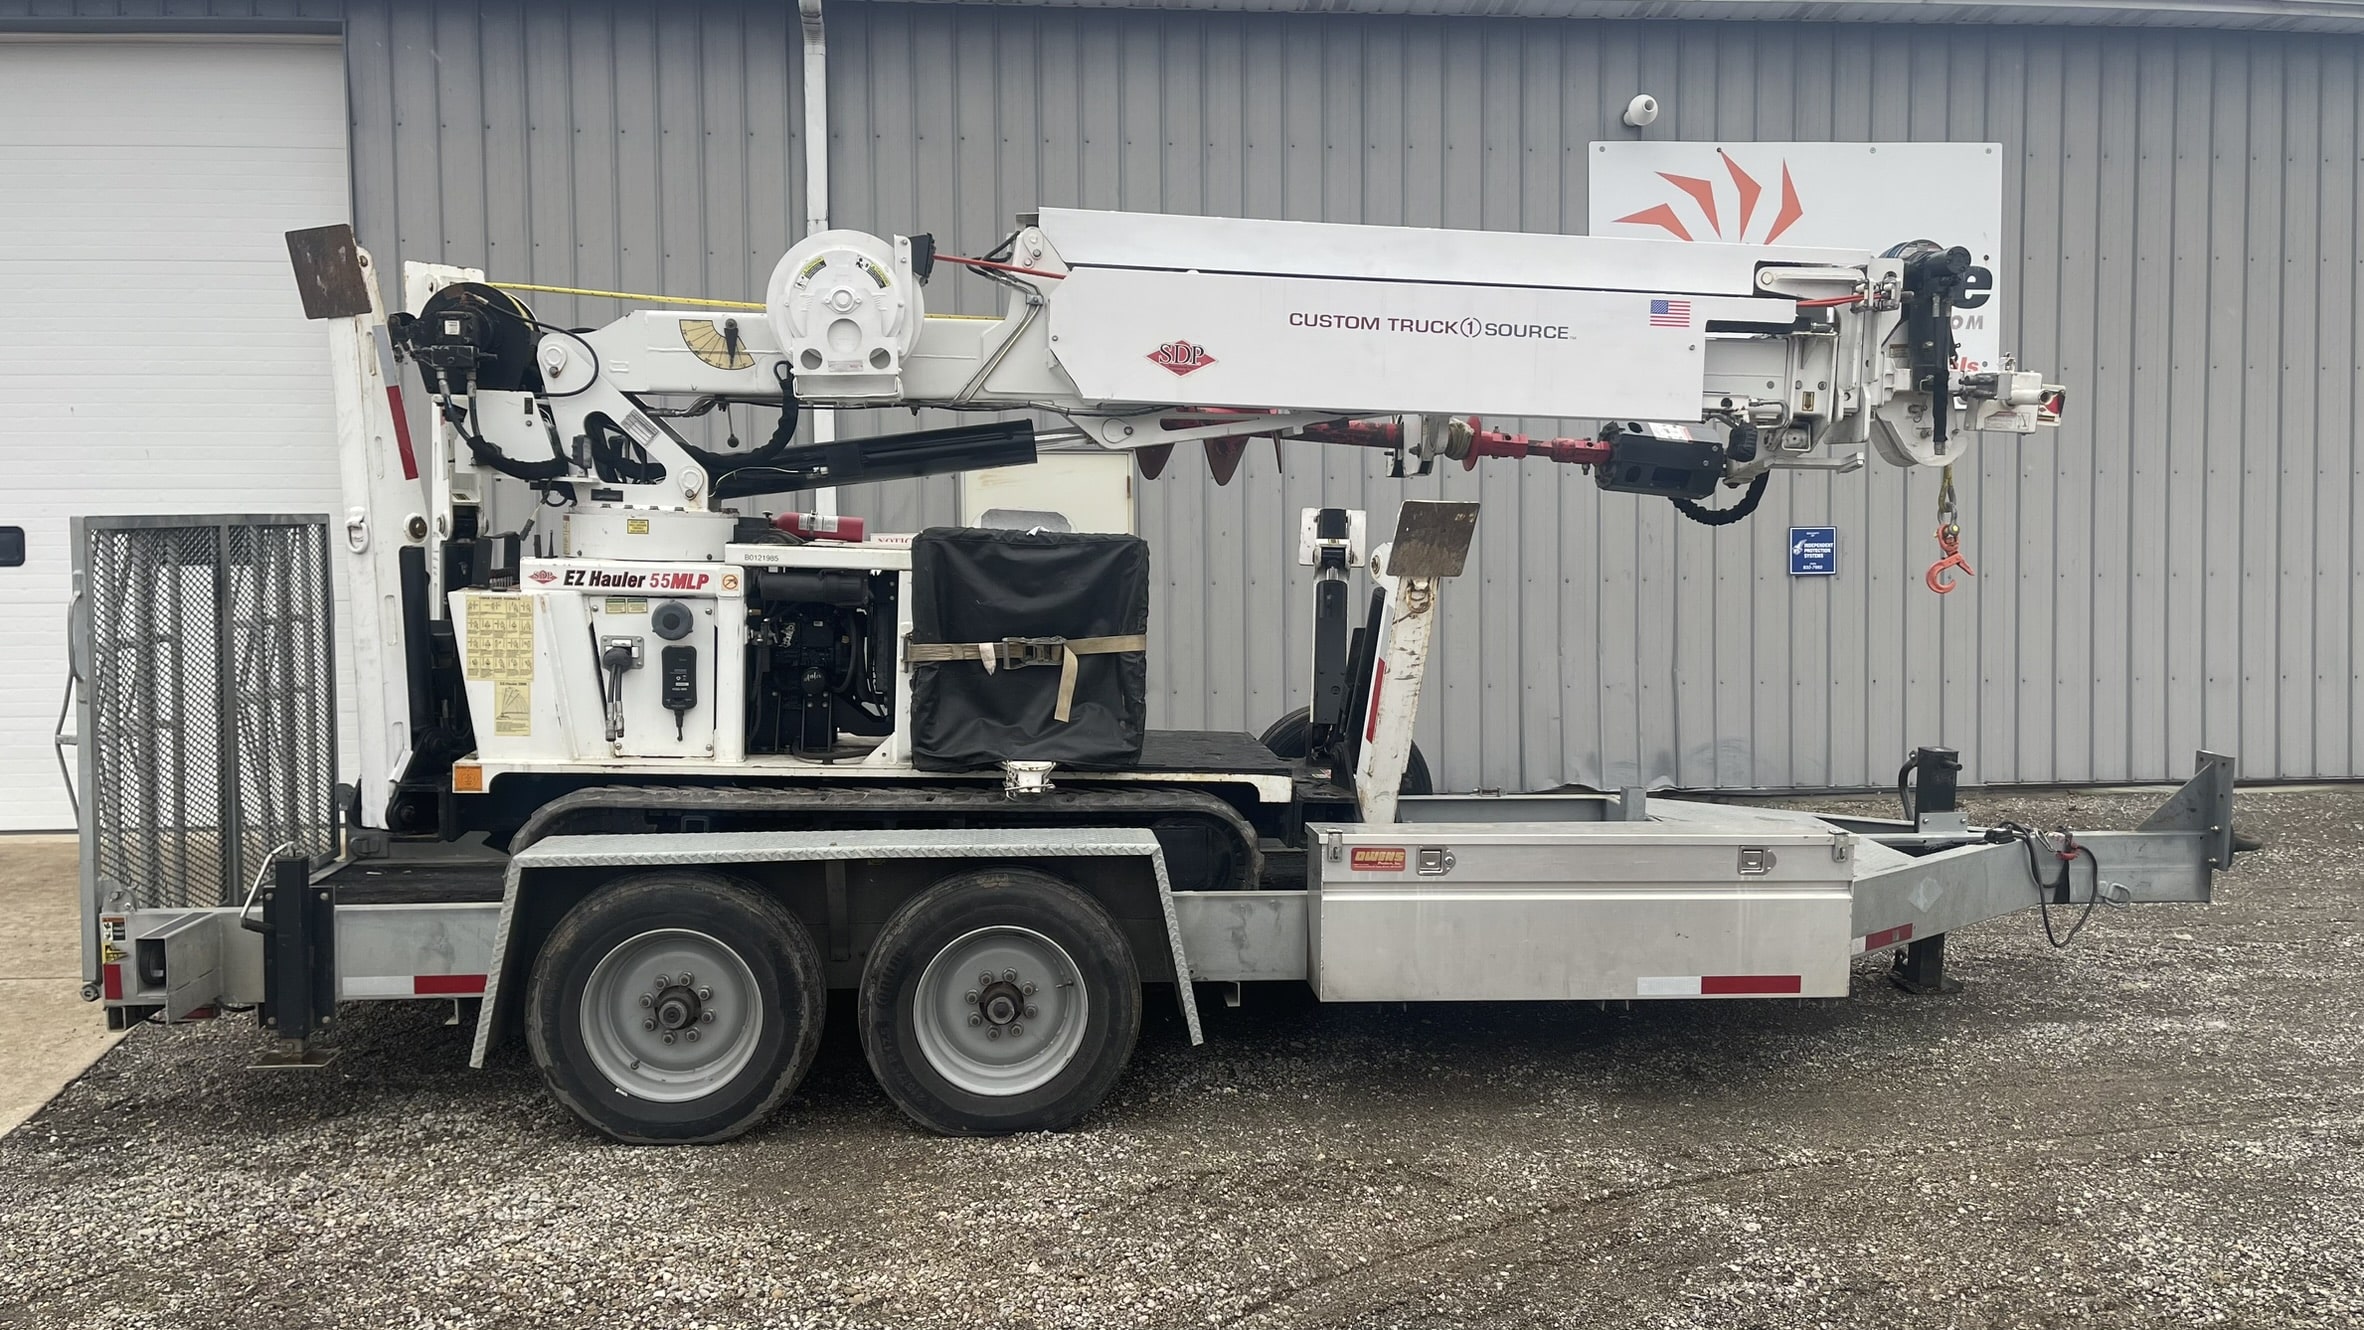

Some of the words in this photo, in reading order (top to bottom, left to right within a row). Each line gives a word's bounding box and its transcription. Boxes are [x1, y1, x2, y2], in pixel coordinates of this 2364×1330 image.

[1289, 312, 1380, 331] CUSTOM
[1387, 317, 1458, 335] TRUCK
[1484, 322, 1569, 340] SOURCE
[1158, 343, 1205, 365] SDP
[563, 569, 586, 587] EZ
[589, 570, 646, 588] Hauler
[649, 573, 710, 590] 55MLP
[1354, 851, 1405, 861] OWENS
